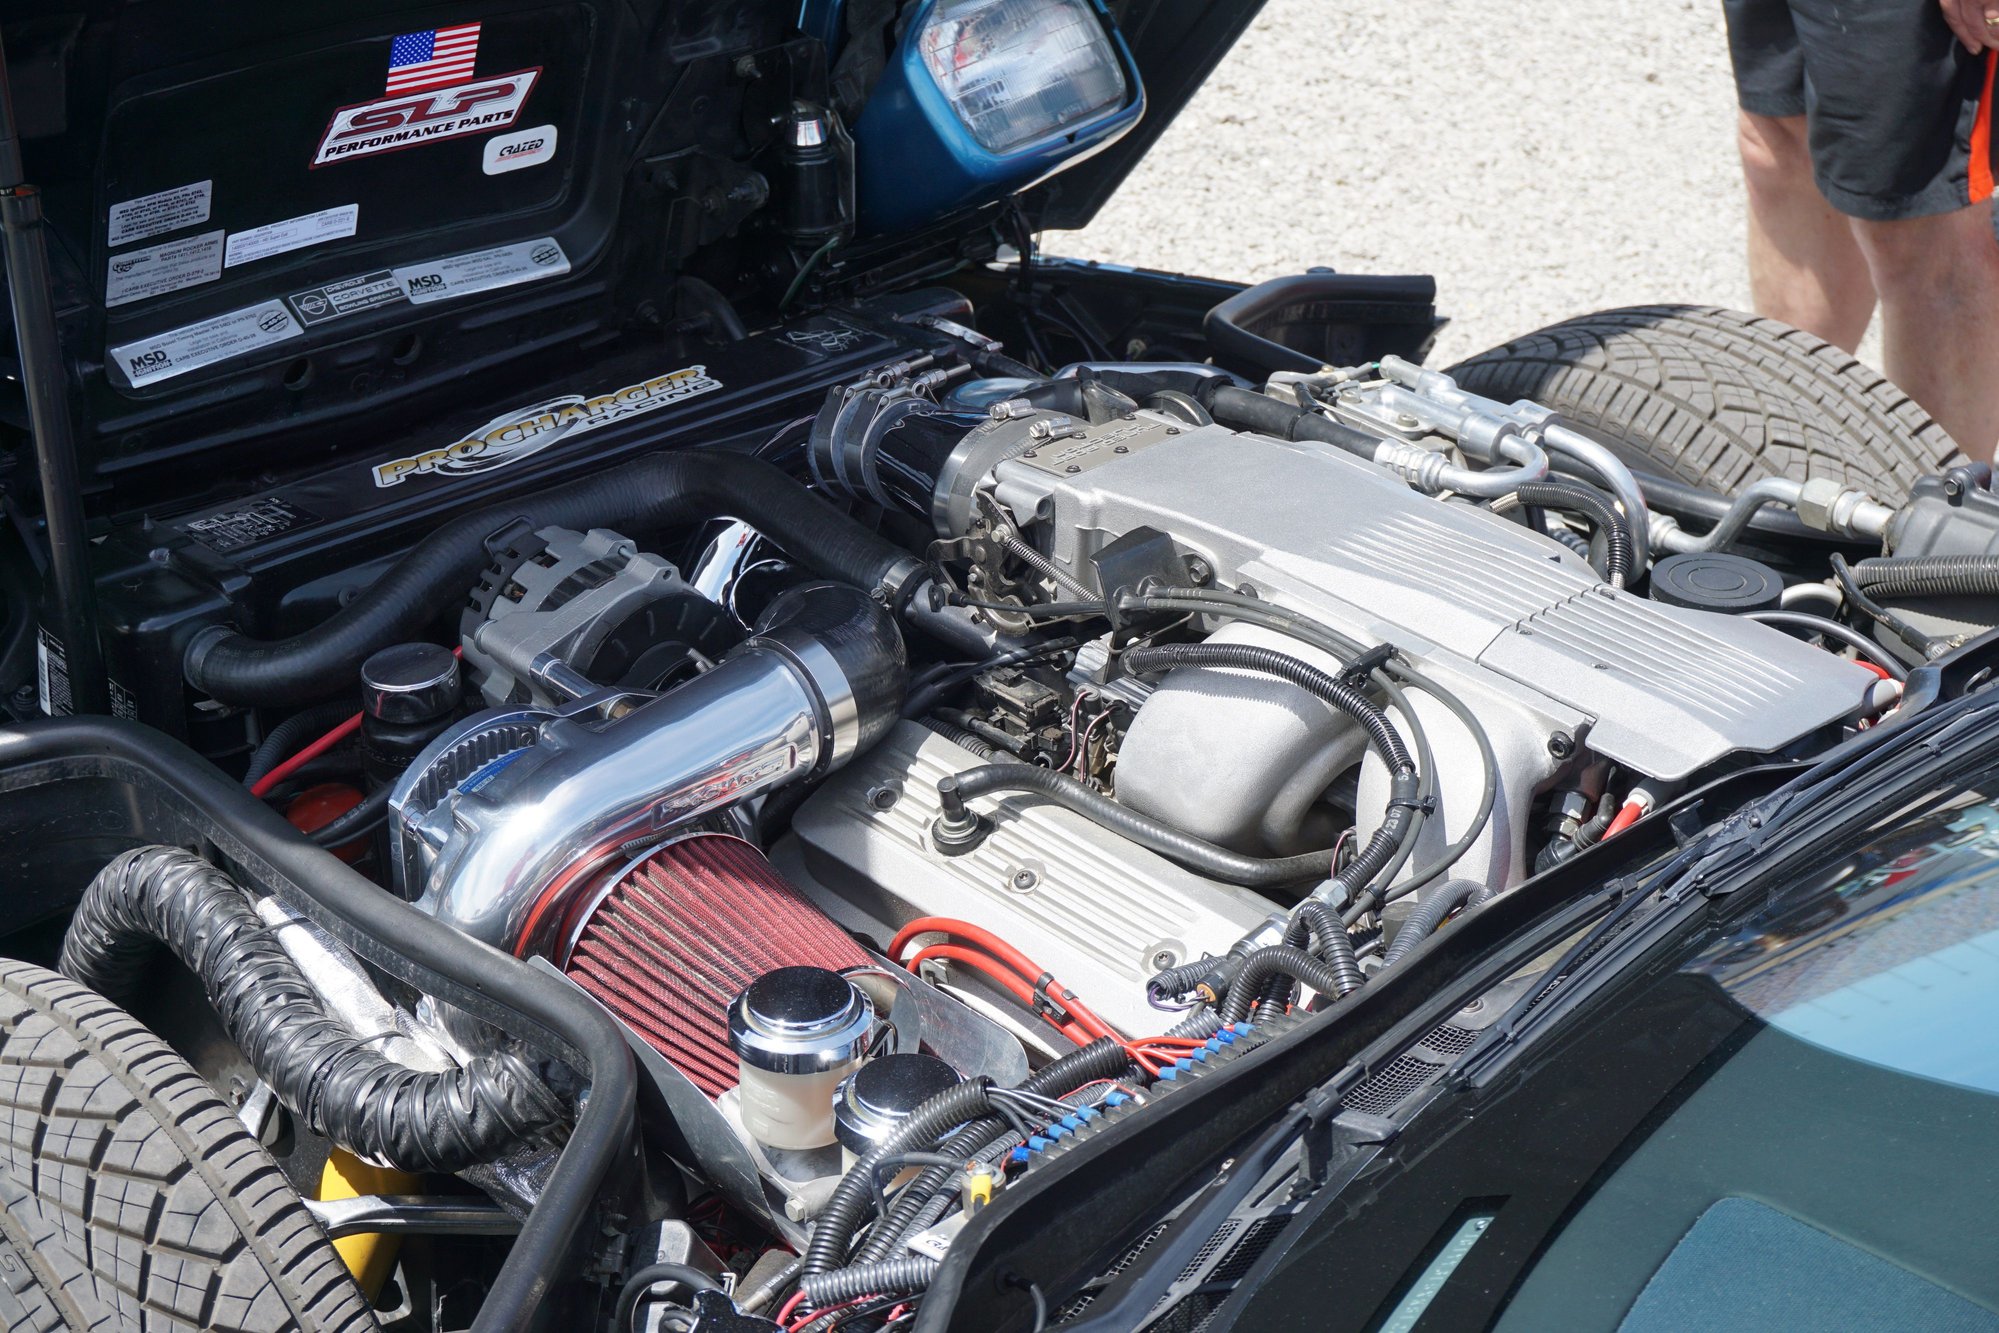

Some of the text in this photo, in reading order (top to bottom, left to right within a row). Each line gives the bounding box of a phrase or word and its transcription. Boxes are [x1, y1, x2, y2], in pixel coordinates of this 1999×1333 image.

[332, 83, 516, 140] SLP
[325, 109, 515, 158] PERFORMANCE PARTS
[499, 138, 545, 157] CRAZED
[160, 249, 182, 258] MAGNUM
[183, 244, 203, 252] ROCKER
[326, 277, 366, 293] CHEVROLET
[333, 280, 395, 302] CORVETTE
[408, 274, 443, 290] MSD
[411, 283, 447, 296] IGNITION
[338, 299, 369, 311] BOWLING
[129, 350, 167, 370] MSD
[134, 360, 172, 377] IGNITION
[587, 379, 715, 425] RACING
[379, 369, 704, 484] PROCHARGER
